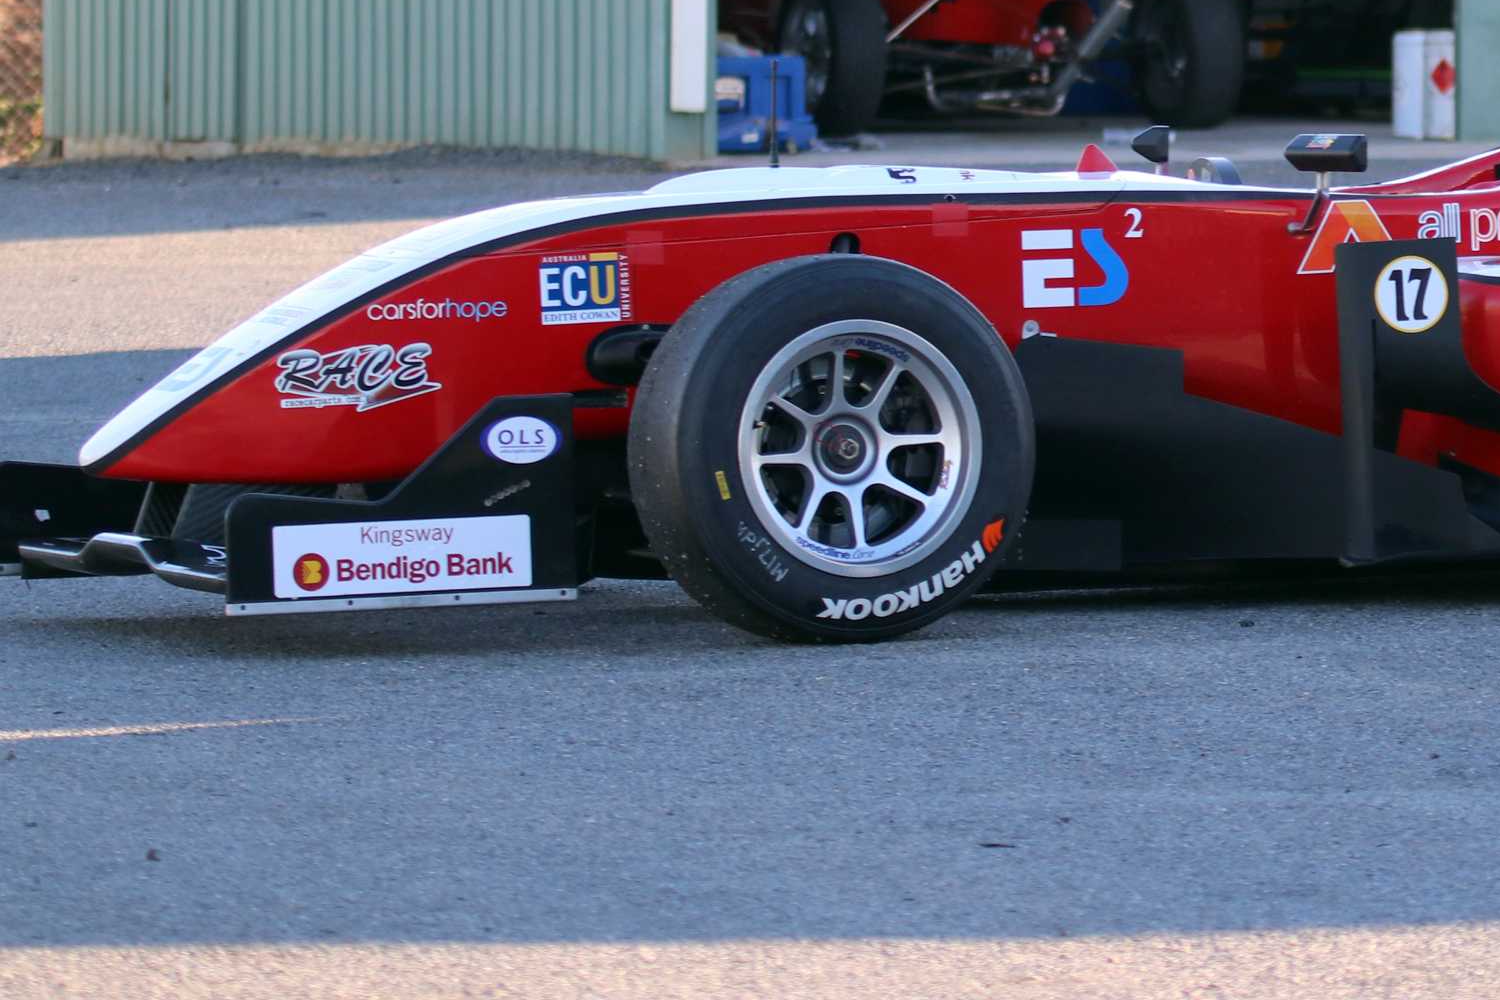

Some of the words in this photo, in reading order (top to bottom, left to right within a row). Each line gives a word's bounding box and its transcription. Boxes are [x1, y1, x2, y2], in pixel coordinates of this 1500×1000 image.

[1123, 207, 1144, 239] 2
[1417, 202, 1460, 242] all
[539, 265, 616, 308] ECU
[619, 253, 632, 319] UNIVERSITY
[1388, 267, 1433, 322] 17
[366, 297, 508, 323] carsforhope
[544, 312, 577, 323] EDITH
[580, 310, 618, 321] COWAN
[275, 343, 433, 393] RACE
[360, 526, 454, 547] Kingsway
[336, 556, 440, 584] Bendigo
[447, 552, 514, 577] Bank
